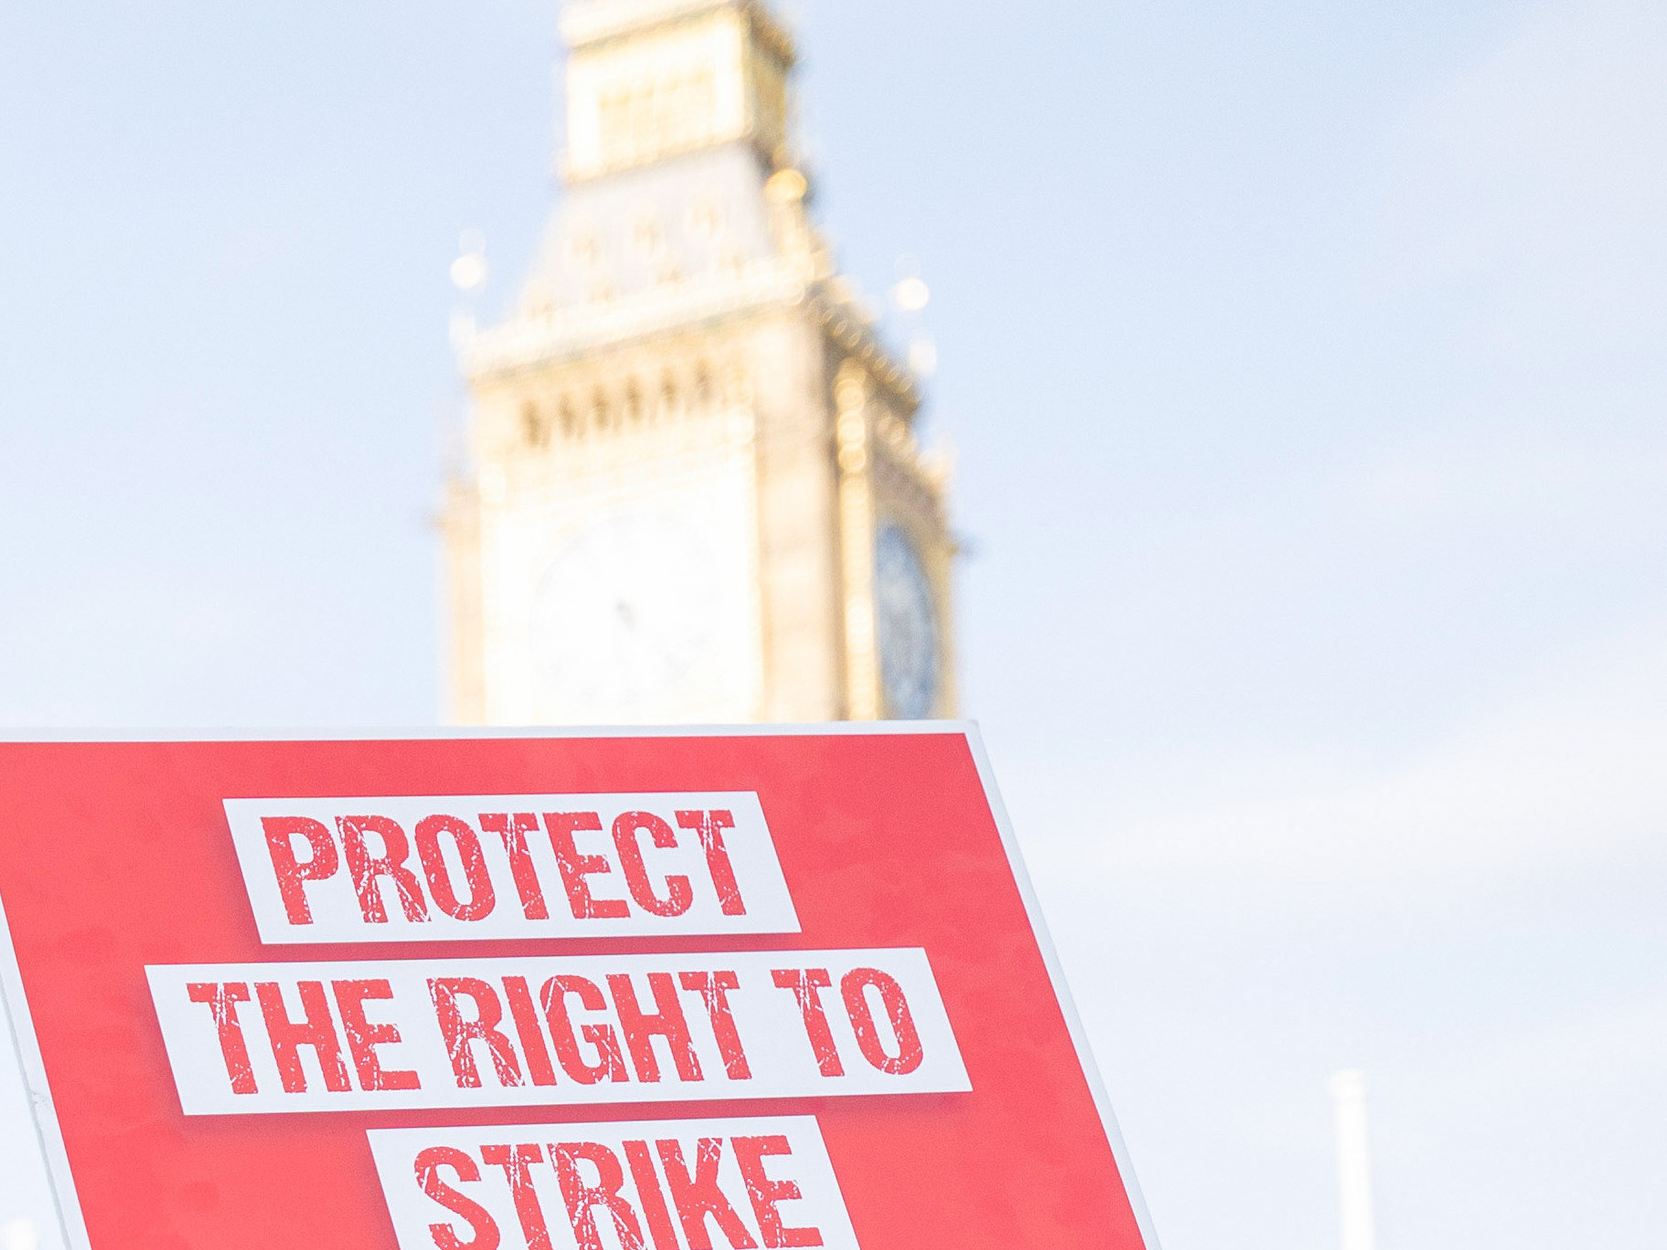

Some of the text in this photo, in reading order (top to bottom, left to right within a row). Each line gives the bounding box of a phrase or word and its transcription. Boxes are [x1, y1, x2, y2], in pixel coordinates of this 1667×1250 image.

[260, 809, 747, 926] PROTECT
[186, 967, 924, 1096] THE RIGHT TO
